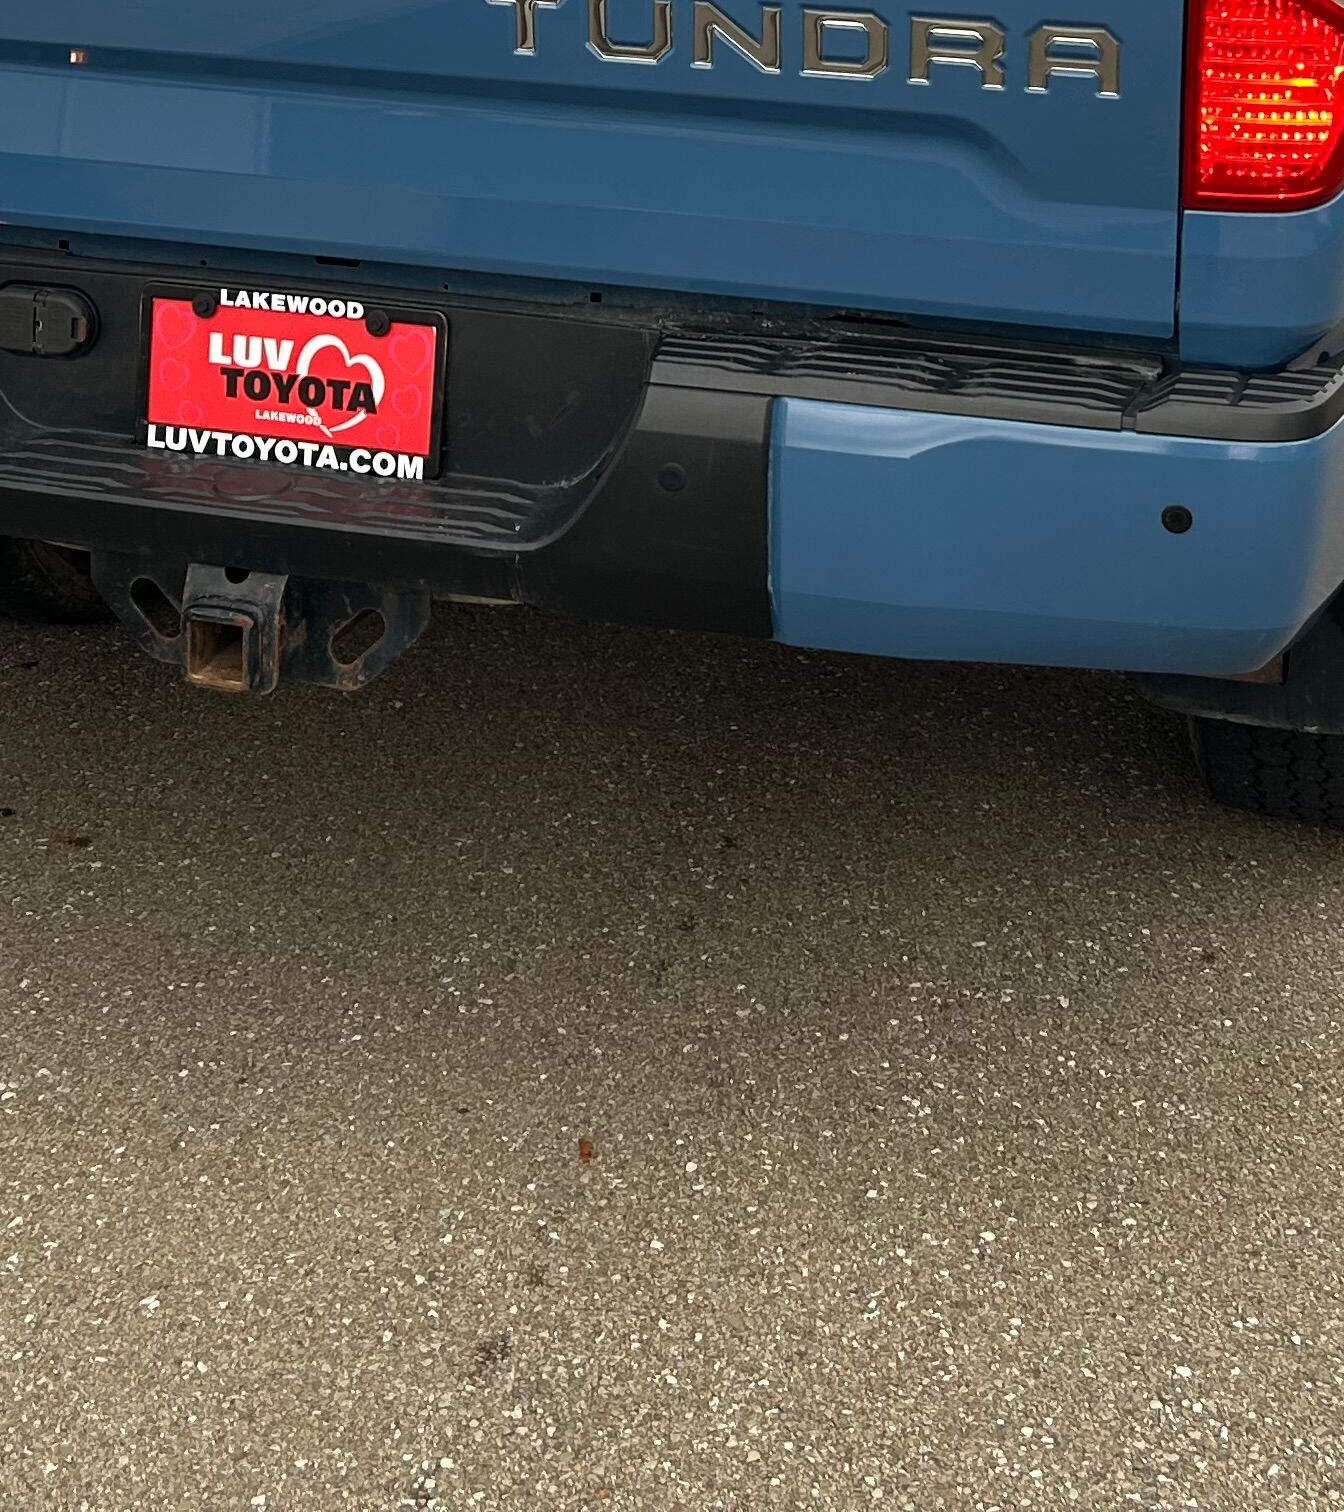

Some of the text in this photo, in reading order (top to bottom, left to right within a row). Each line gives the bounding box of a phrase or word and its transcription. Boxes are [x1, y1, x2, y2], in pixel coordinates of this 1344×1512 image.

[219, 287, 366, 321] LAKEWOOD
[207, 331, 296, 371] LUV
[219, 367, 378, 414] TOYOTA
[255, 408, 323, 427] LAKEWOOD
[146, 423, 425, 481] LUVTOYOTA.COM
